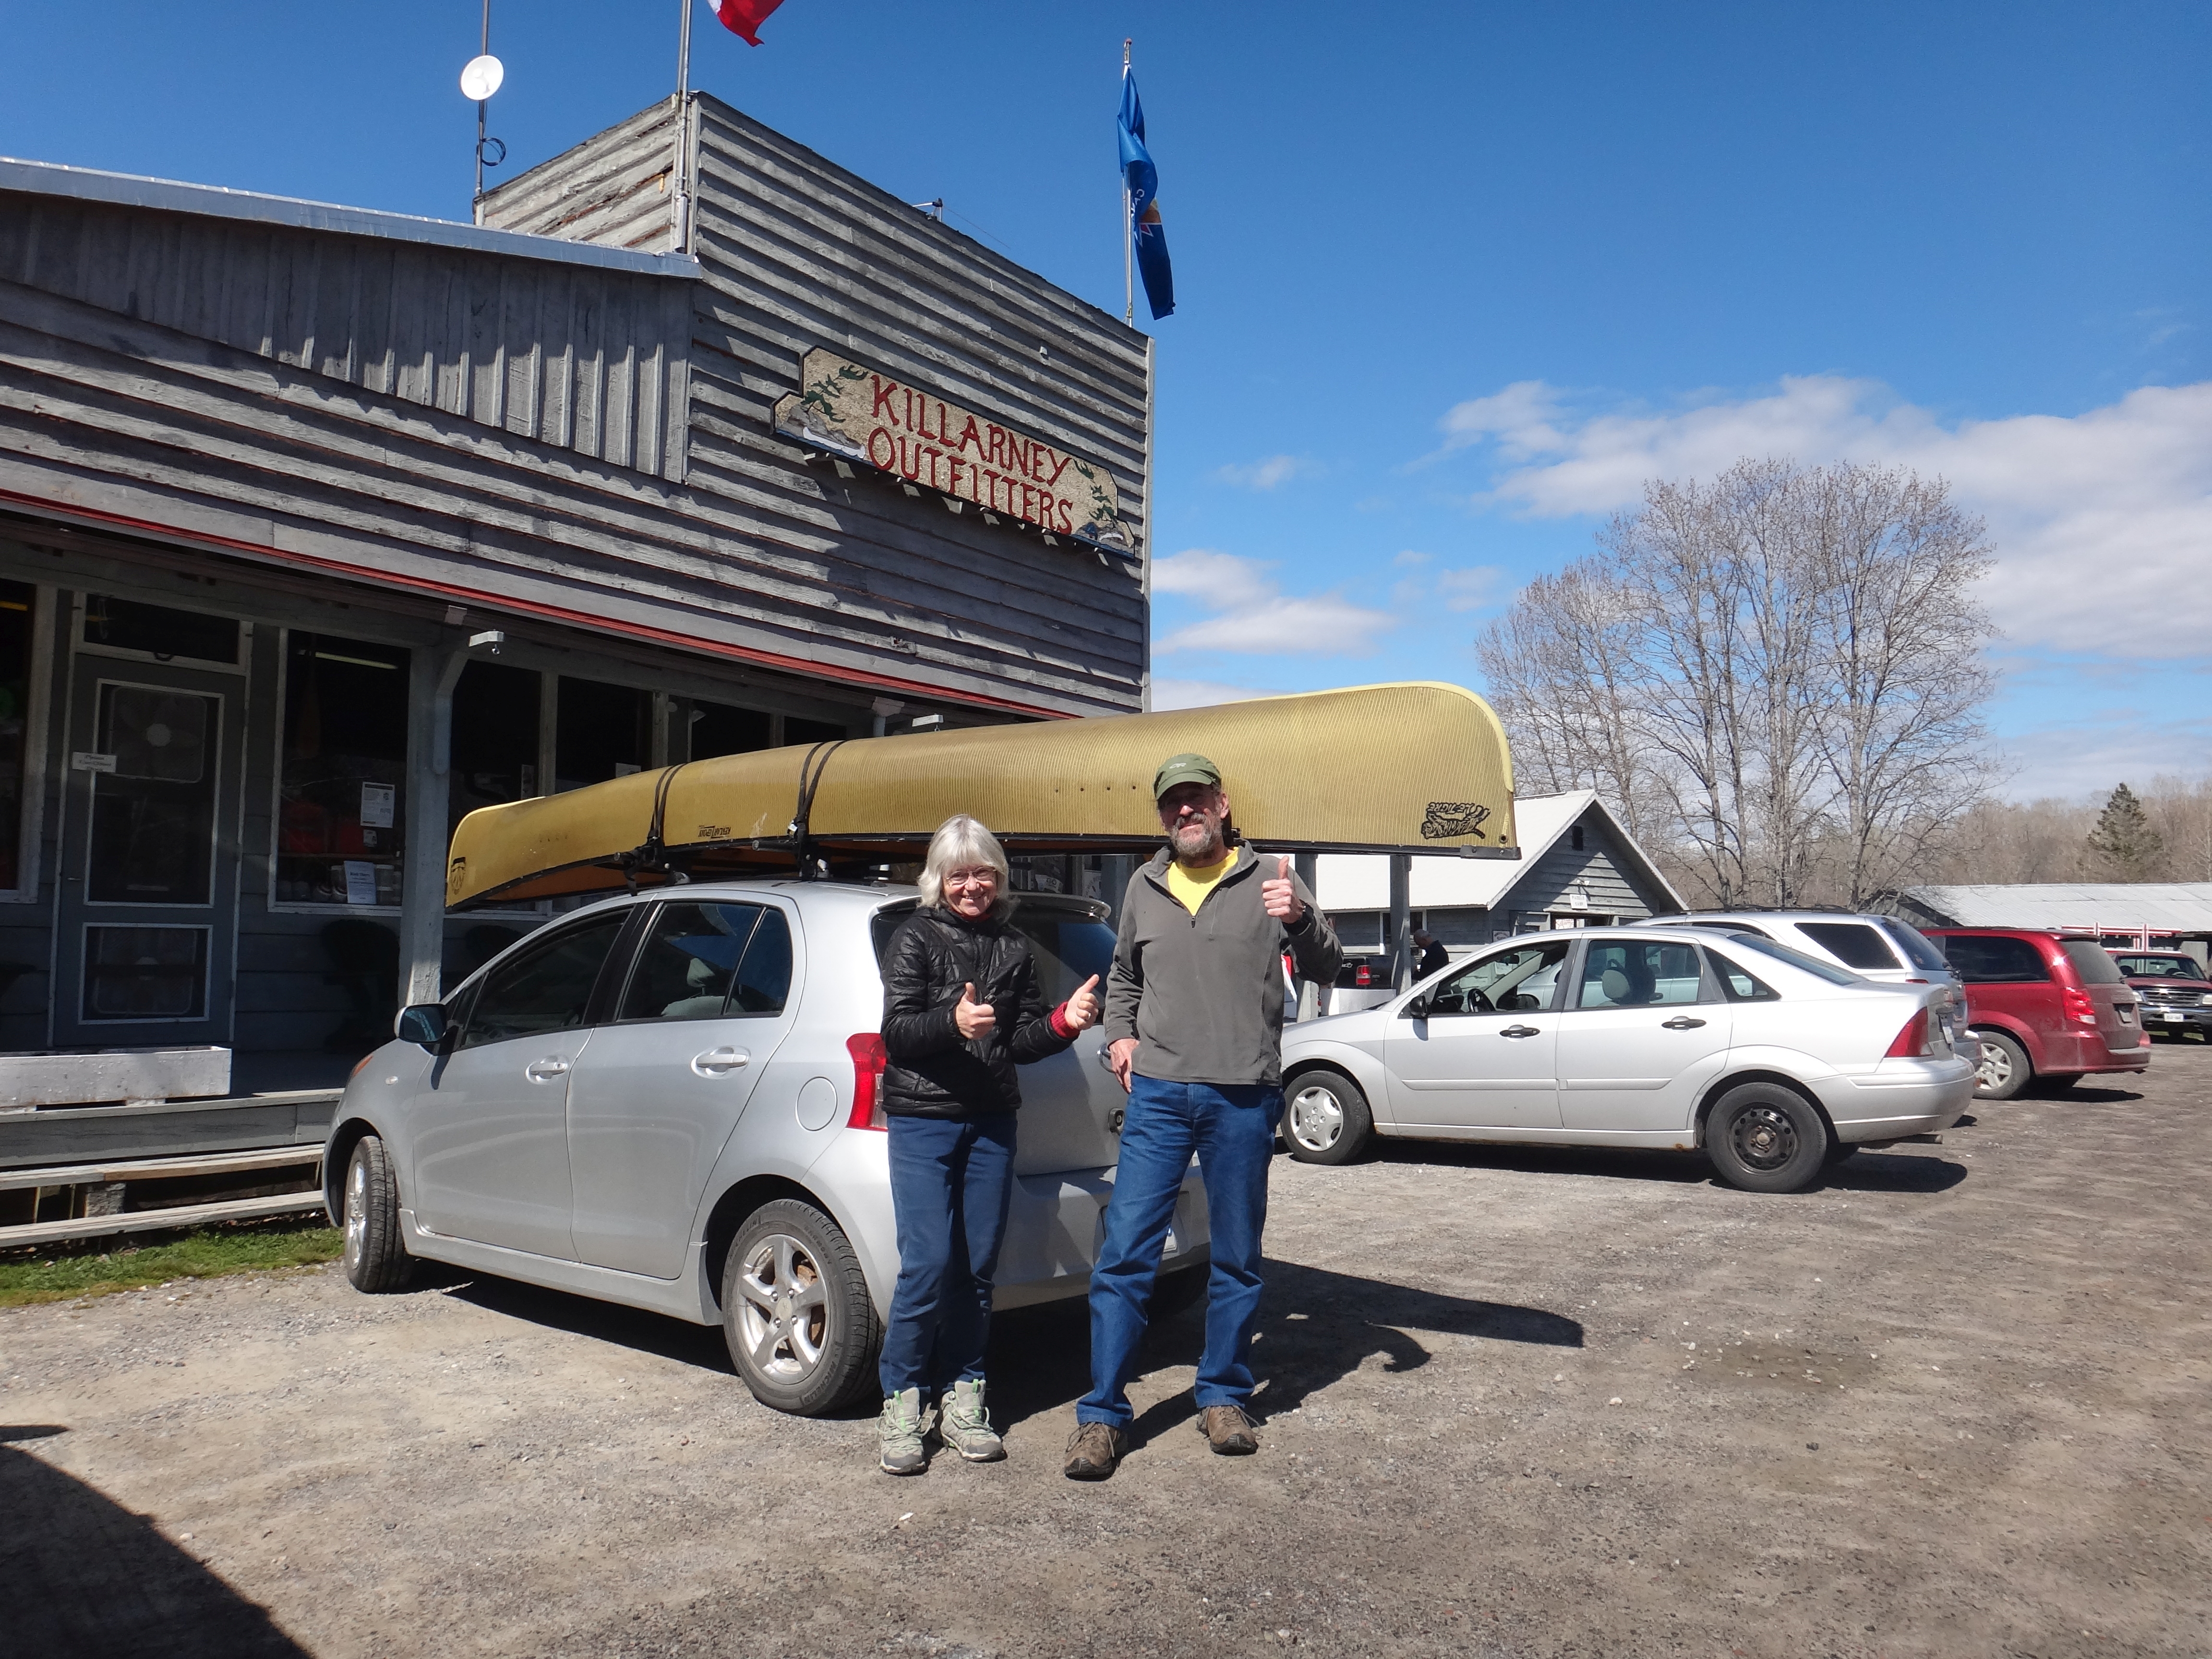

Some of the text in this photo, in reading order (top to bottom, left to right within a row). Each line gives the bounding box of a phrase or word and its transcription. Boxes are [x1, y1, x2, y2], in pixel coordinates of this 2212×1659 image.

[868, 426, 1073, 535] OUTFITTERS
[870, 374, 1072, 486] KILLARNEY
[1427, 802, 1456, 815] TIGRE
